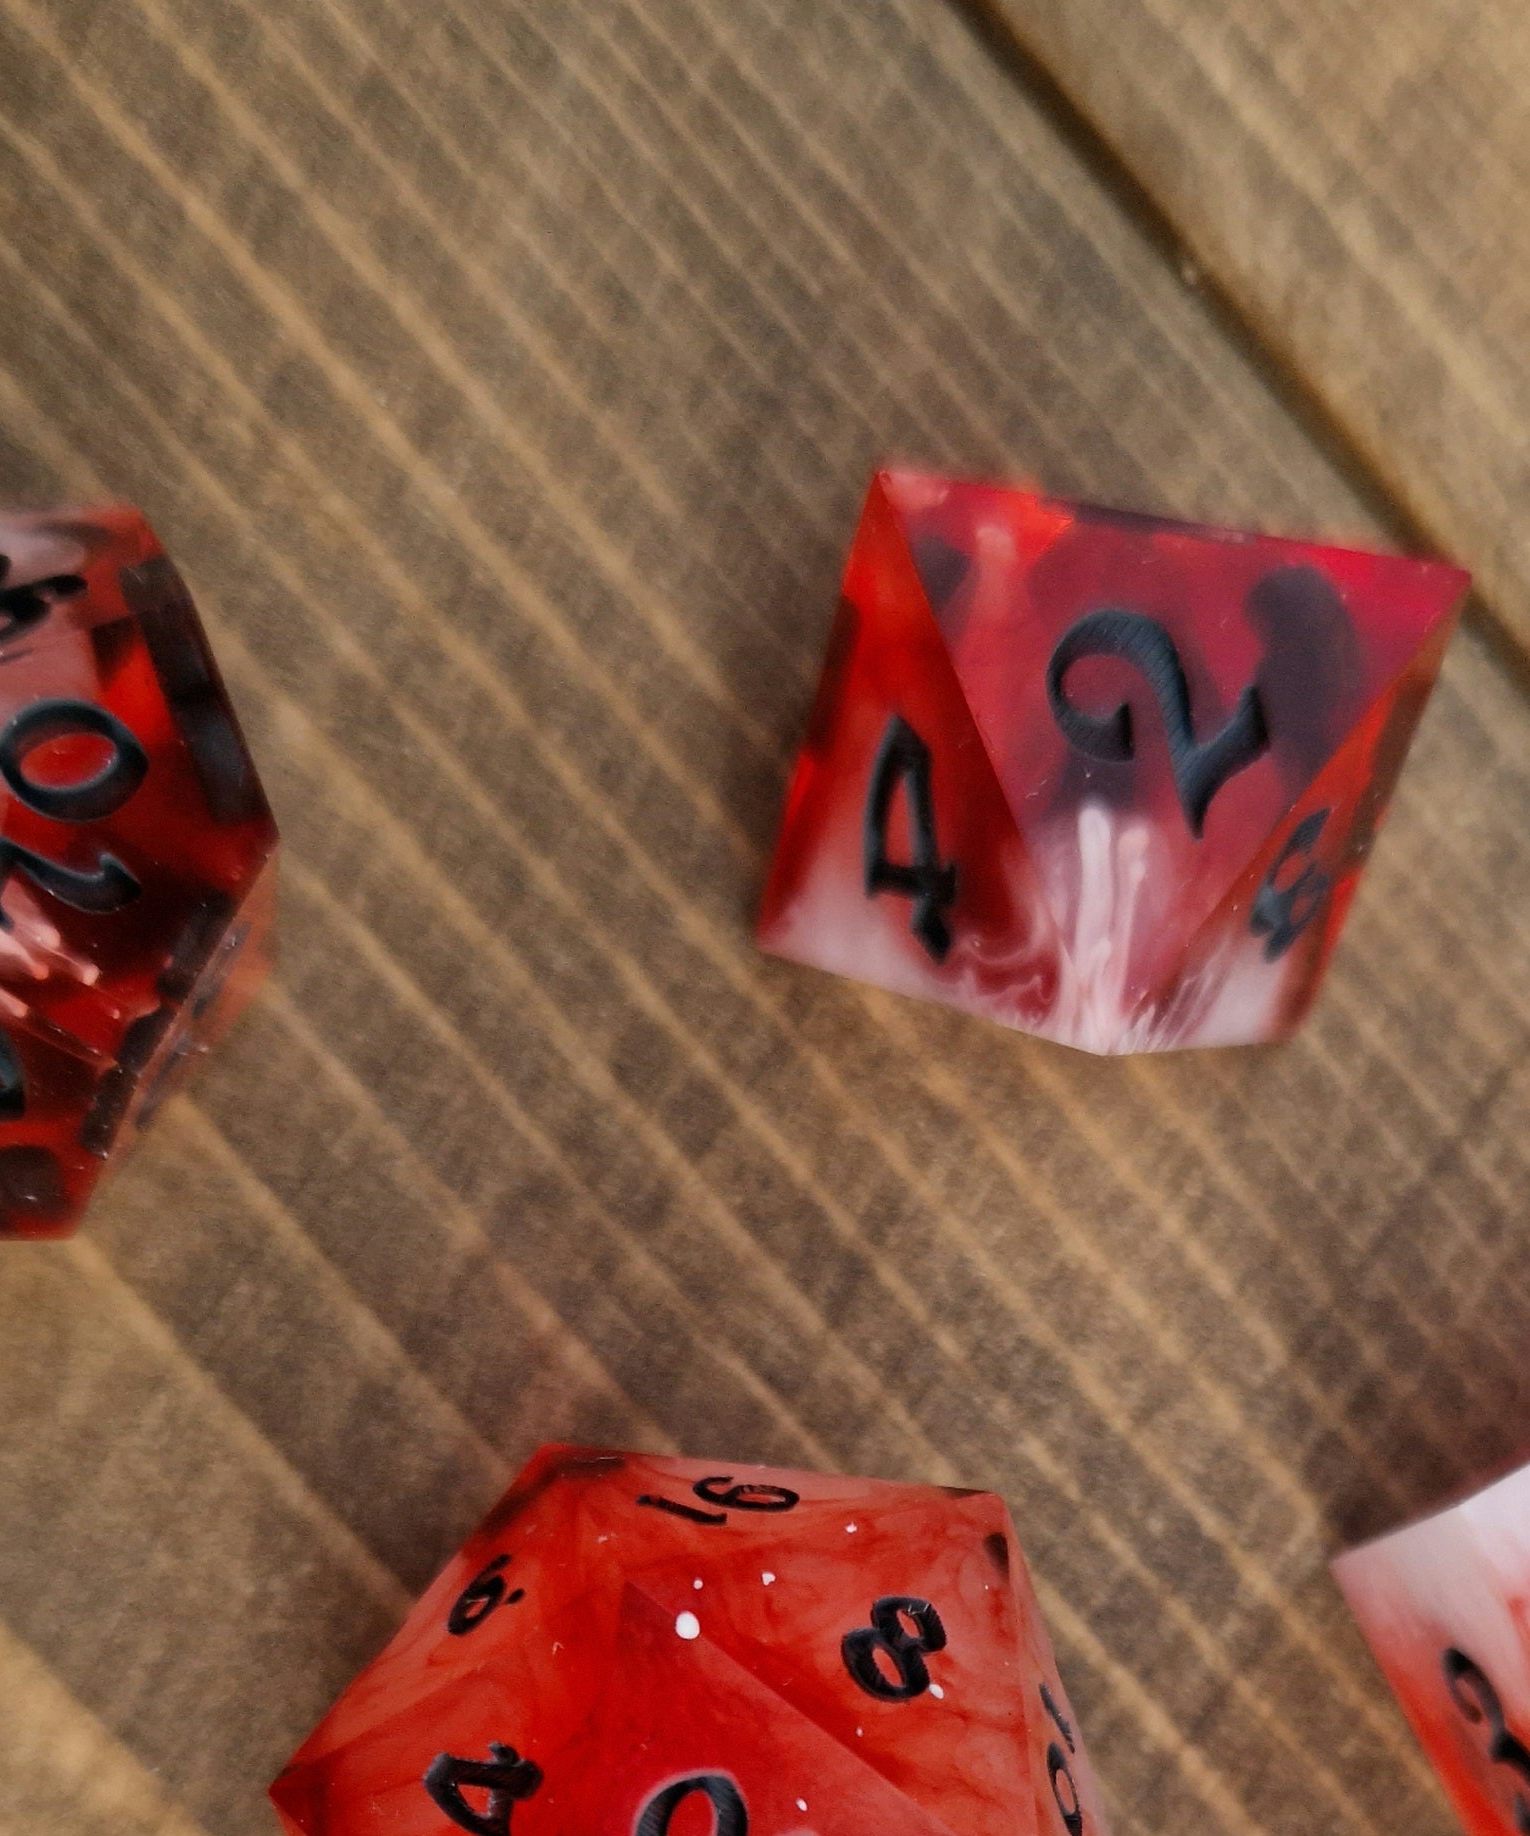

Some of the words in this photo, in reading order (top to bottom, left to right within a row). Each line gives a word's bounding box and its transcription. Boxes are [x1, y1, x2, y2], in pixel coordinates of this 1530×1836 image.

[1046, 609, 1270, 840] 2
[864, 715, 958, 965] 4
[637, 1475, 801, 1525] 16
[841, 1596, 948, 1701] 8
